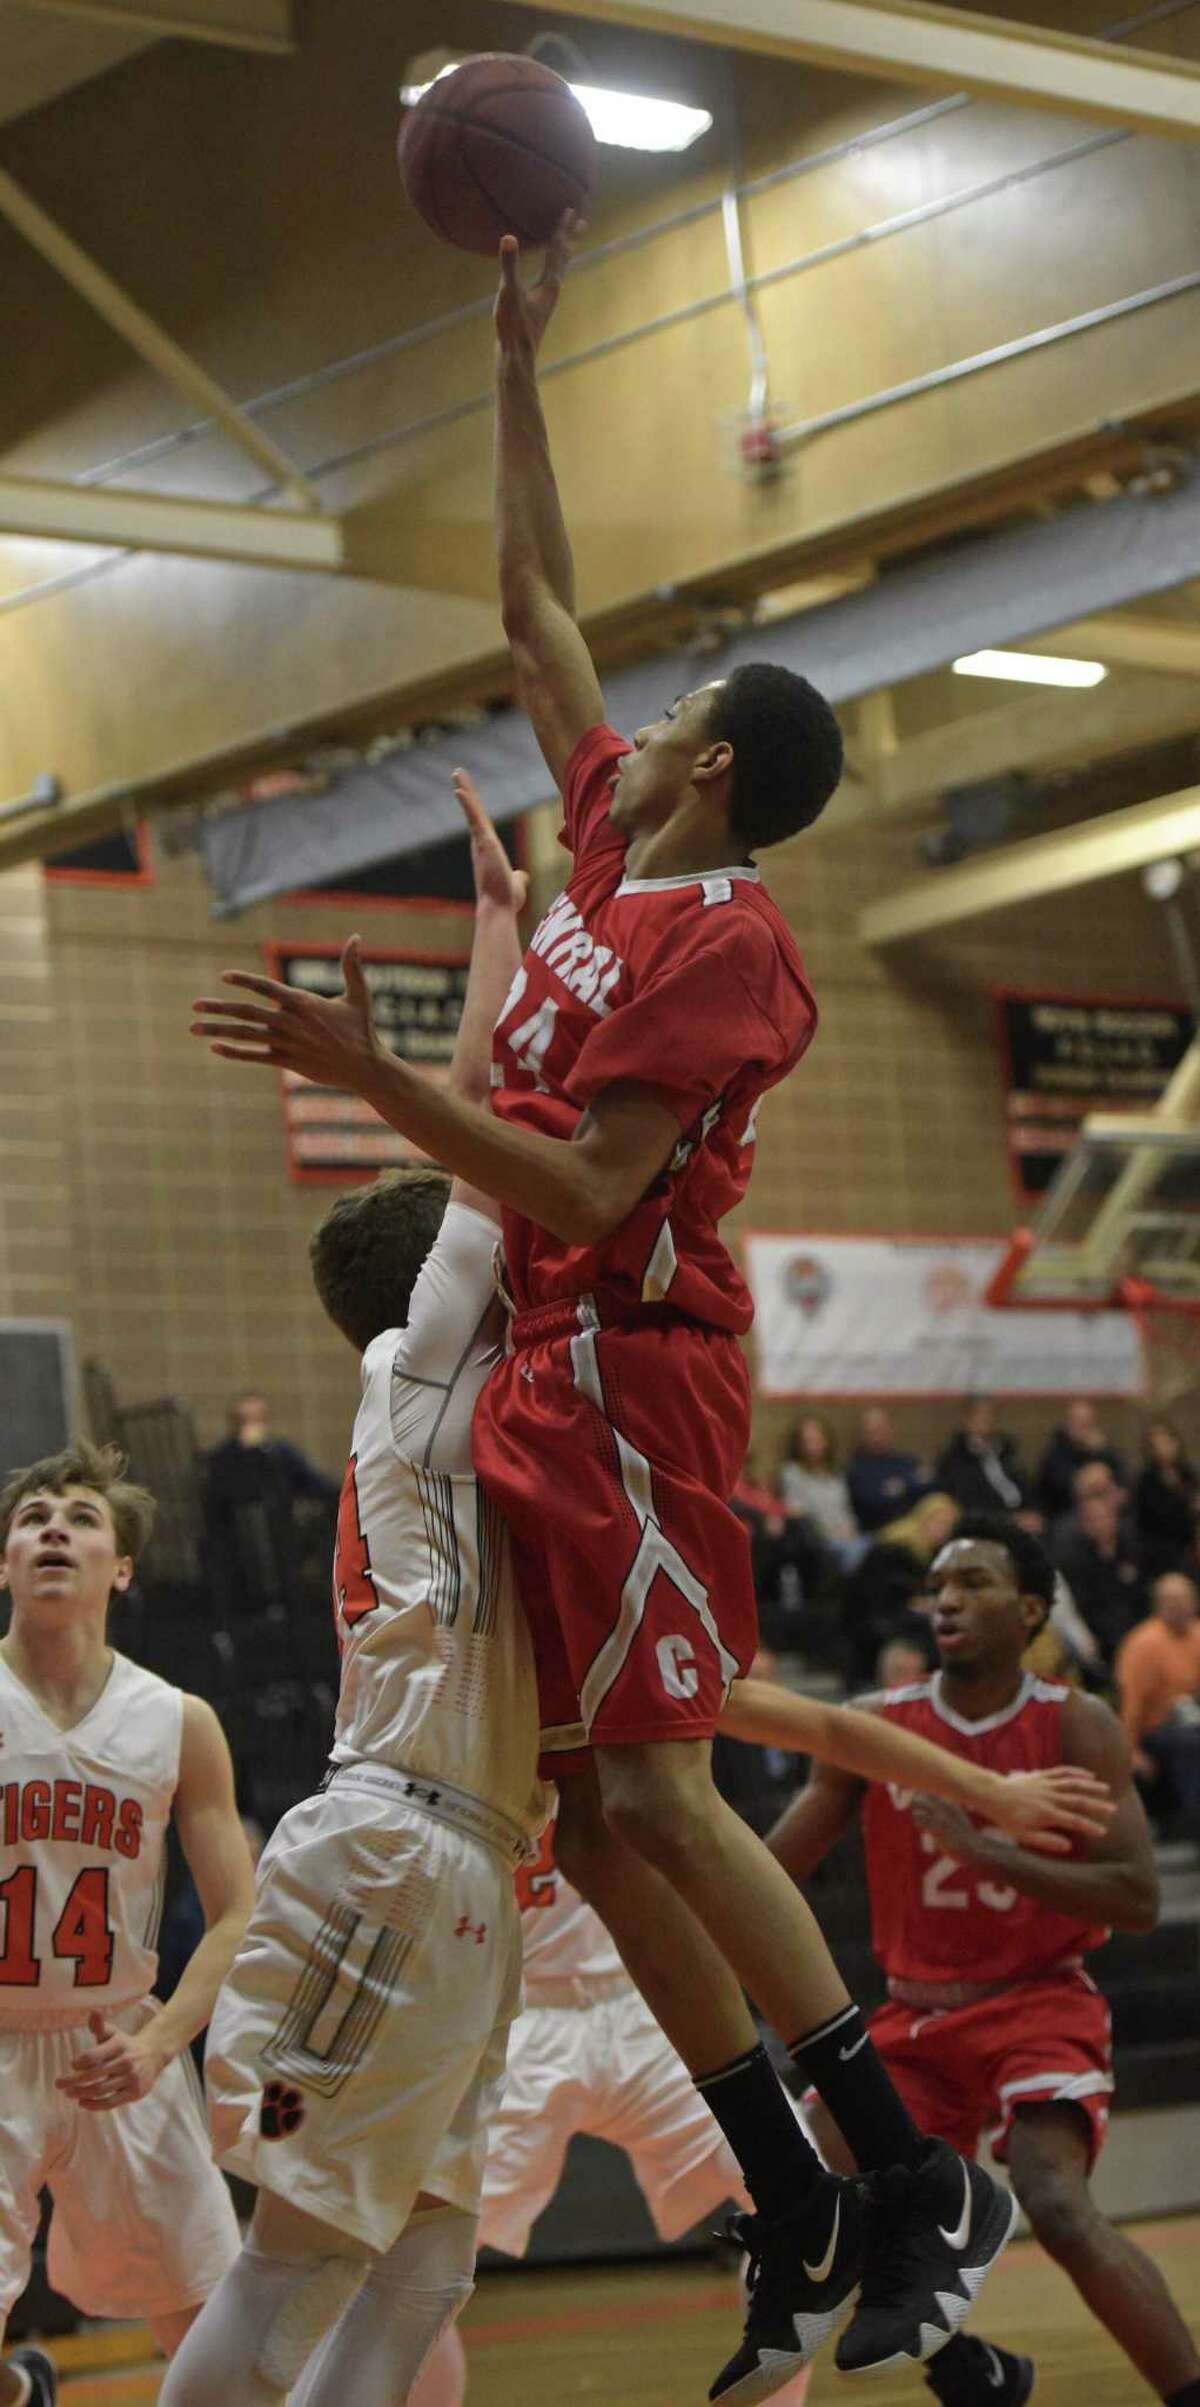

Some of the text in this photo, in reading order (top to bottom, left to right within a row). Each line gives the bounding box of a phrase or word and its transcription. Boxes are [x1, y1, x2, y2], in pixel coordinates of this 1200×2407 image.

[655, 1633, 699, 1699] C
[0, 1779, 144, 1860] IGERS
[0, 1865, 115, 1987] 14
